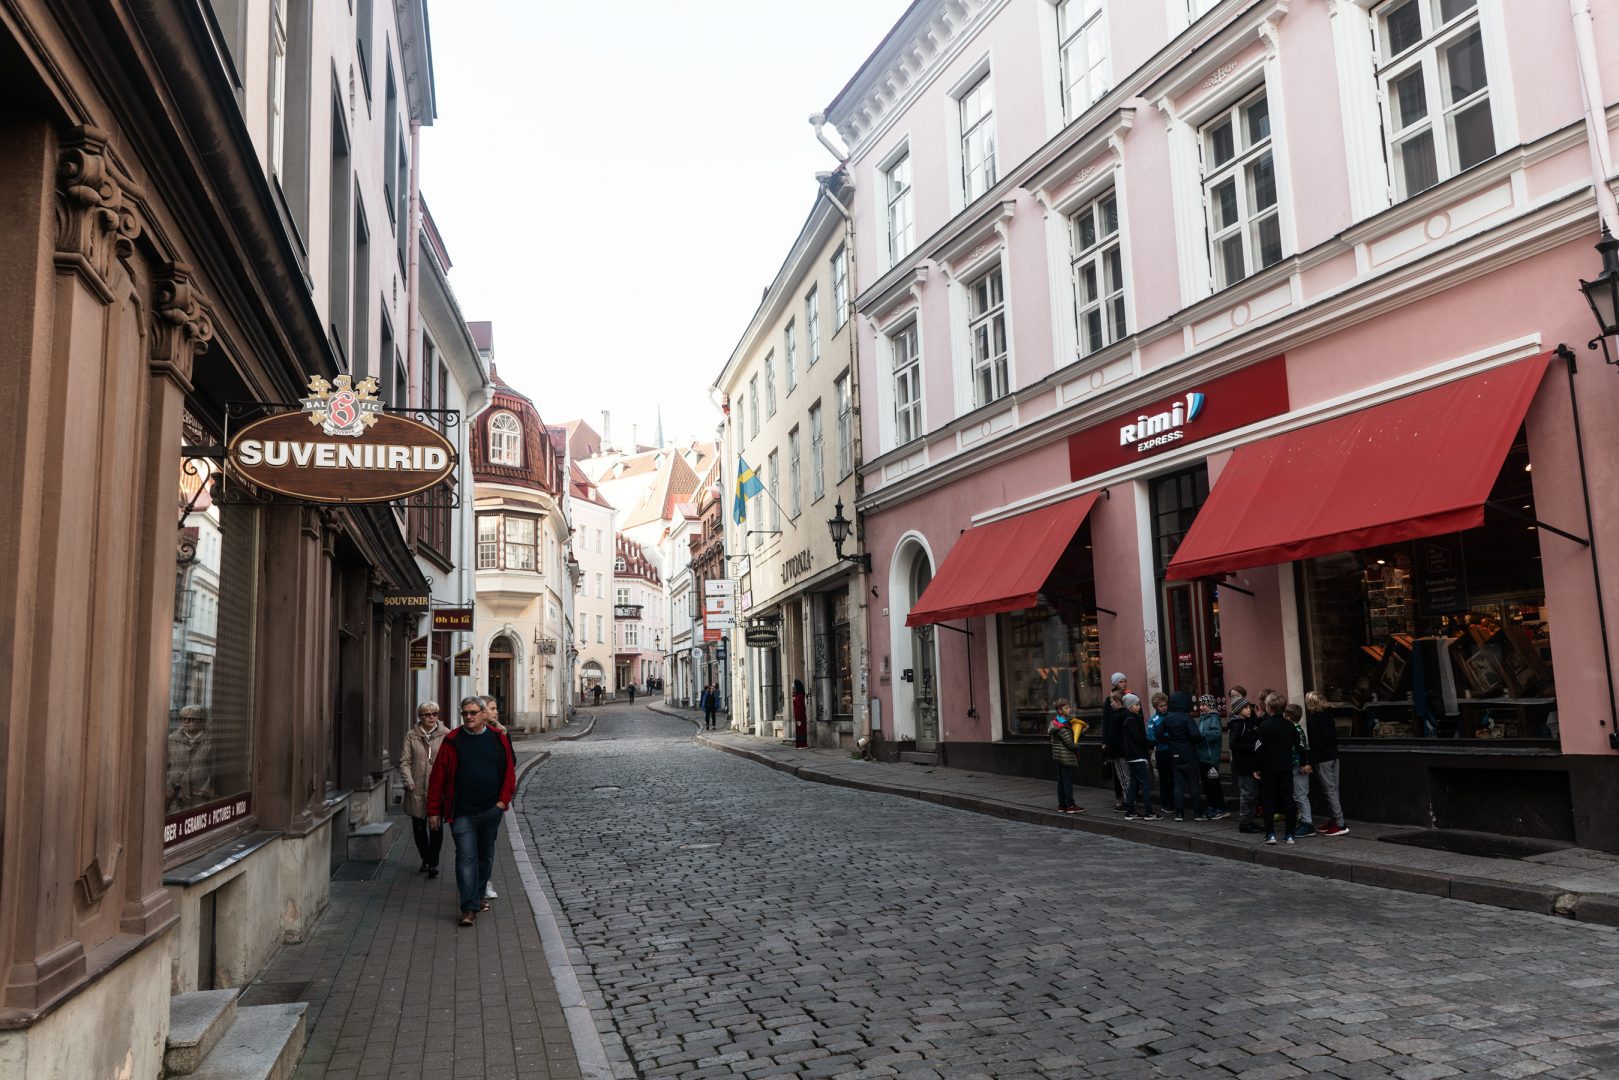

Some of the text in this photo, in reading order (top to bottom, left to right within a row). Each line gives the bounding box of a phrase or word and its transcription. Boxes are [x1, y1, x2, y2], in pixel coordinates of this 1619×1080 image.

[1120, 401, 1184, 446] Rimi
[1138, 430, 1184, 452] EXPRESS
[239, 439, 448, 470] SUVENIIRID
[384, 596, 428, 606] SOUVENIR
[435, 615, 447, 623] Oh
[184, 813, 207, 834] CERAMICS
